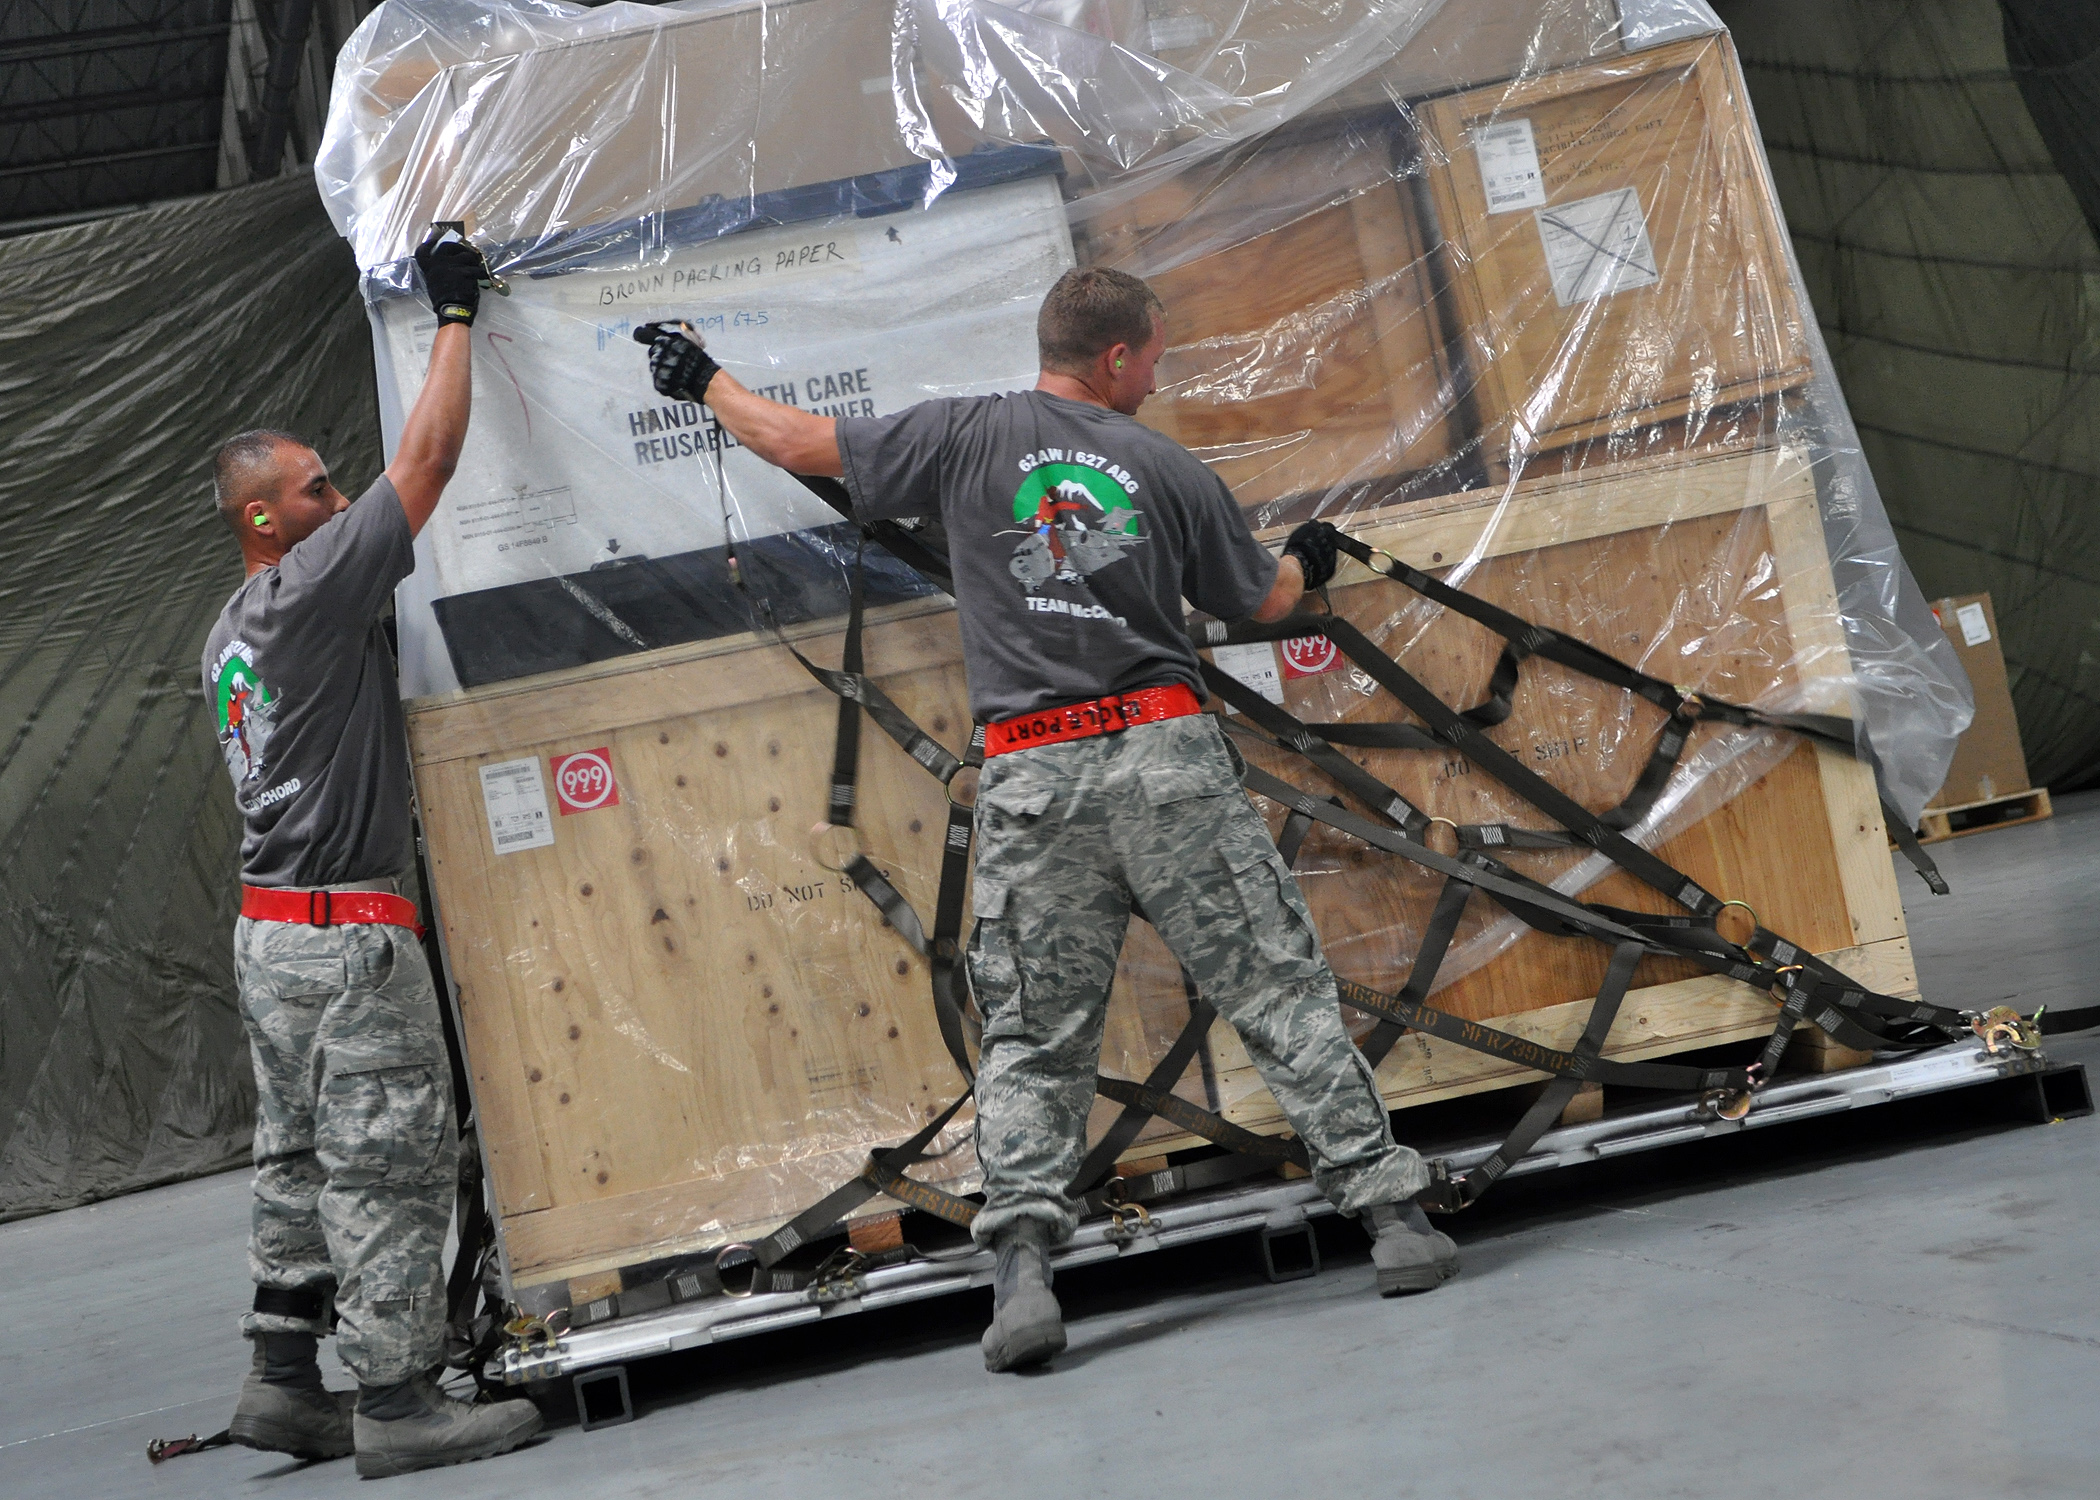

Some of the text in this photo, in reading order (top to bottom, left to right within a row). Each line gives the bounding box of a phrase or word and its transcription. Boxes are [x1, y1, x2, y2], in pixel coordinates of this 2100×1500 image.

[600, 242, 844, 306] BROWN PACKING PAPER
[628, 403, 716, 437] HANDL
[805, 368, 872, 402] CARE
[1075, 451, 1107, 469] 627
[1105, 464, 1140, 494] ABG
[497, 543, 509, 552] GS
[1025, 596, 1070, 614] TEAM
[1289, 634, 1329, 660] 999
[211, 663, 222, 683] 62
[1006, 716, 1061, 744] PORT
[564, 765, 604, 796] 999
[1444, 759, 1471, 778] DO
[747, 893, 773, 911] DO
[787, 882, 824, 902] NOT
